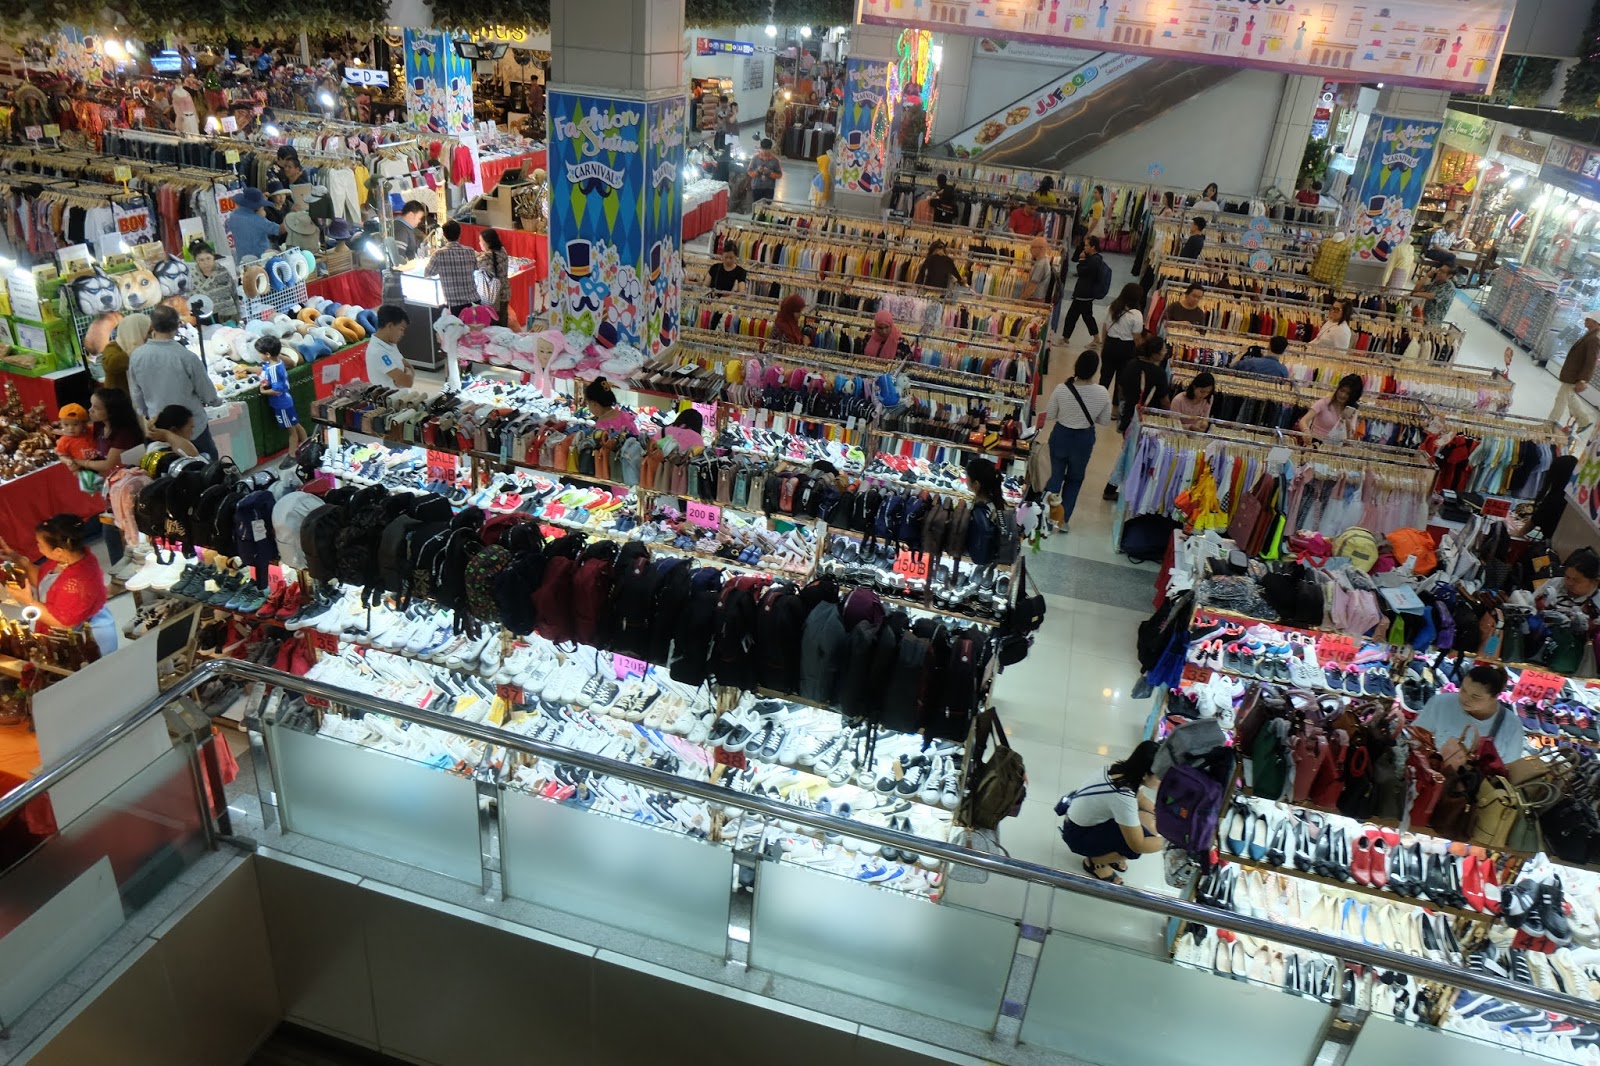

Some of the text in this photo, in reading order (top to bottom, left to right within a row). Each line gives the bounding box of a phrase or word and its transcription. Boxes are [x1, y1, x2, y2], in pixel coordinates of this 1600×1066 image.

[363, 71, 371, 82] D
[553, 106, 640, 141] Fashion
[577, 115, 640, 157] Station
[1382, 124, 1439, 142] Fashion
[1386, 153, 1416, 166] CARNIVAL
[574, 162, 615, 185] CARNIVAL
[117, 213, 148, 235] BOY
[381, 354, 392, 366] 8
[696, 403, 715, 411] SALE
[427, 450, 455, 465] SALE
[689, 508, 706, 519] 200
[317, 637, 336, 652] 35
[618, 657, 646, 675] 120B
[1187, 669, 1207, 682] 35
[1527, 670, 1560, 682] SALE
[501, 687, 519, 700] 37
[719, 750, 743, 768] 38
